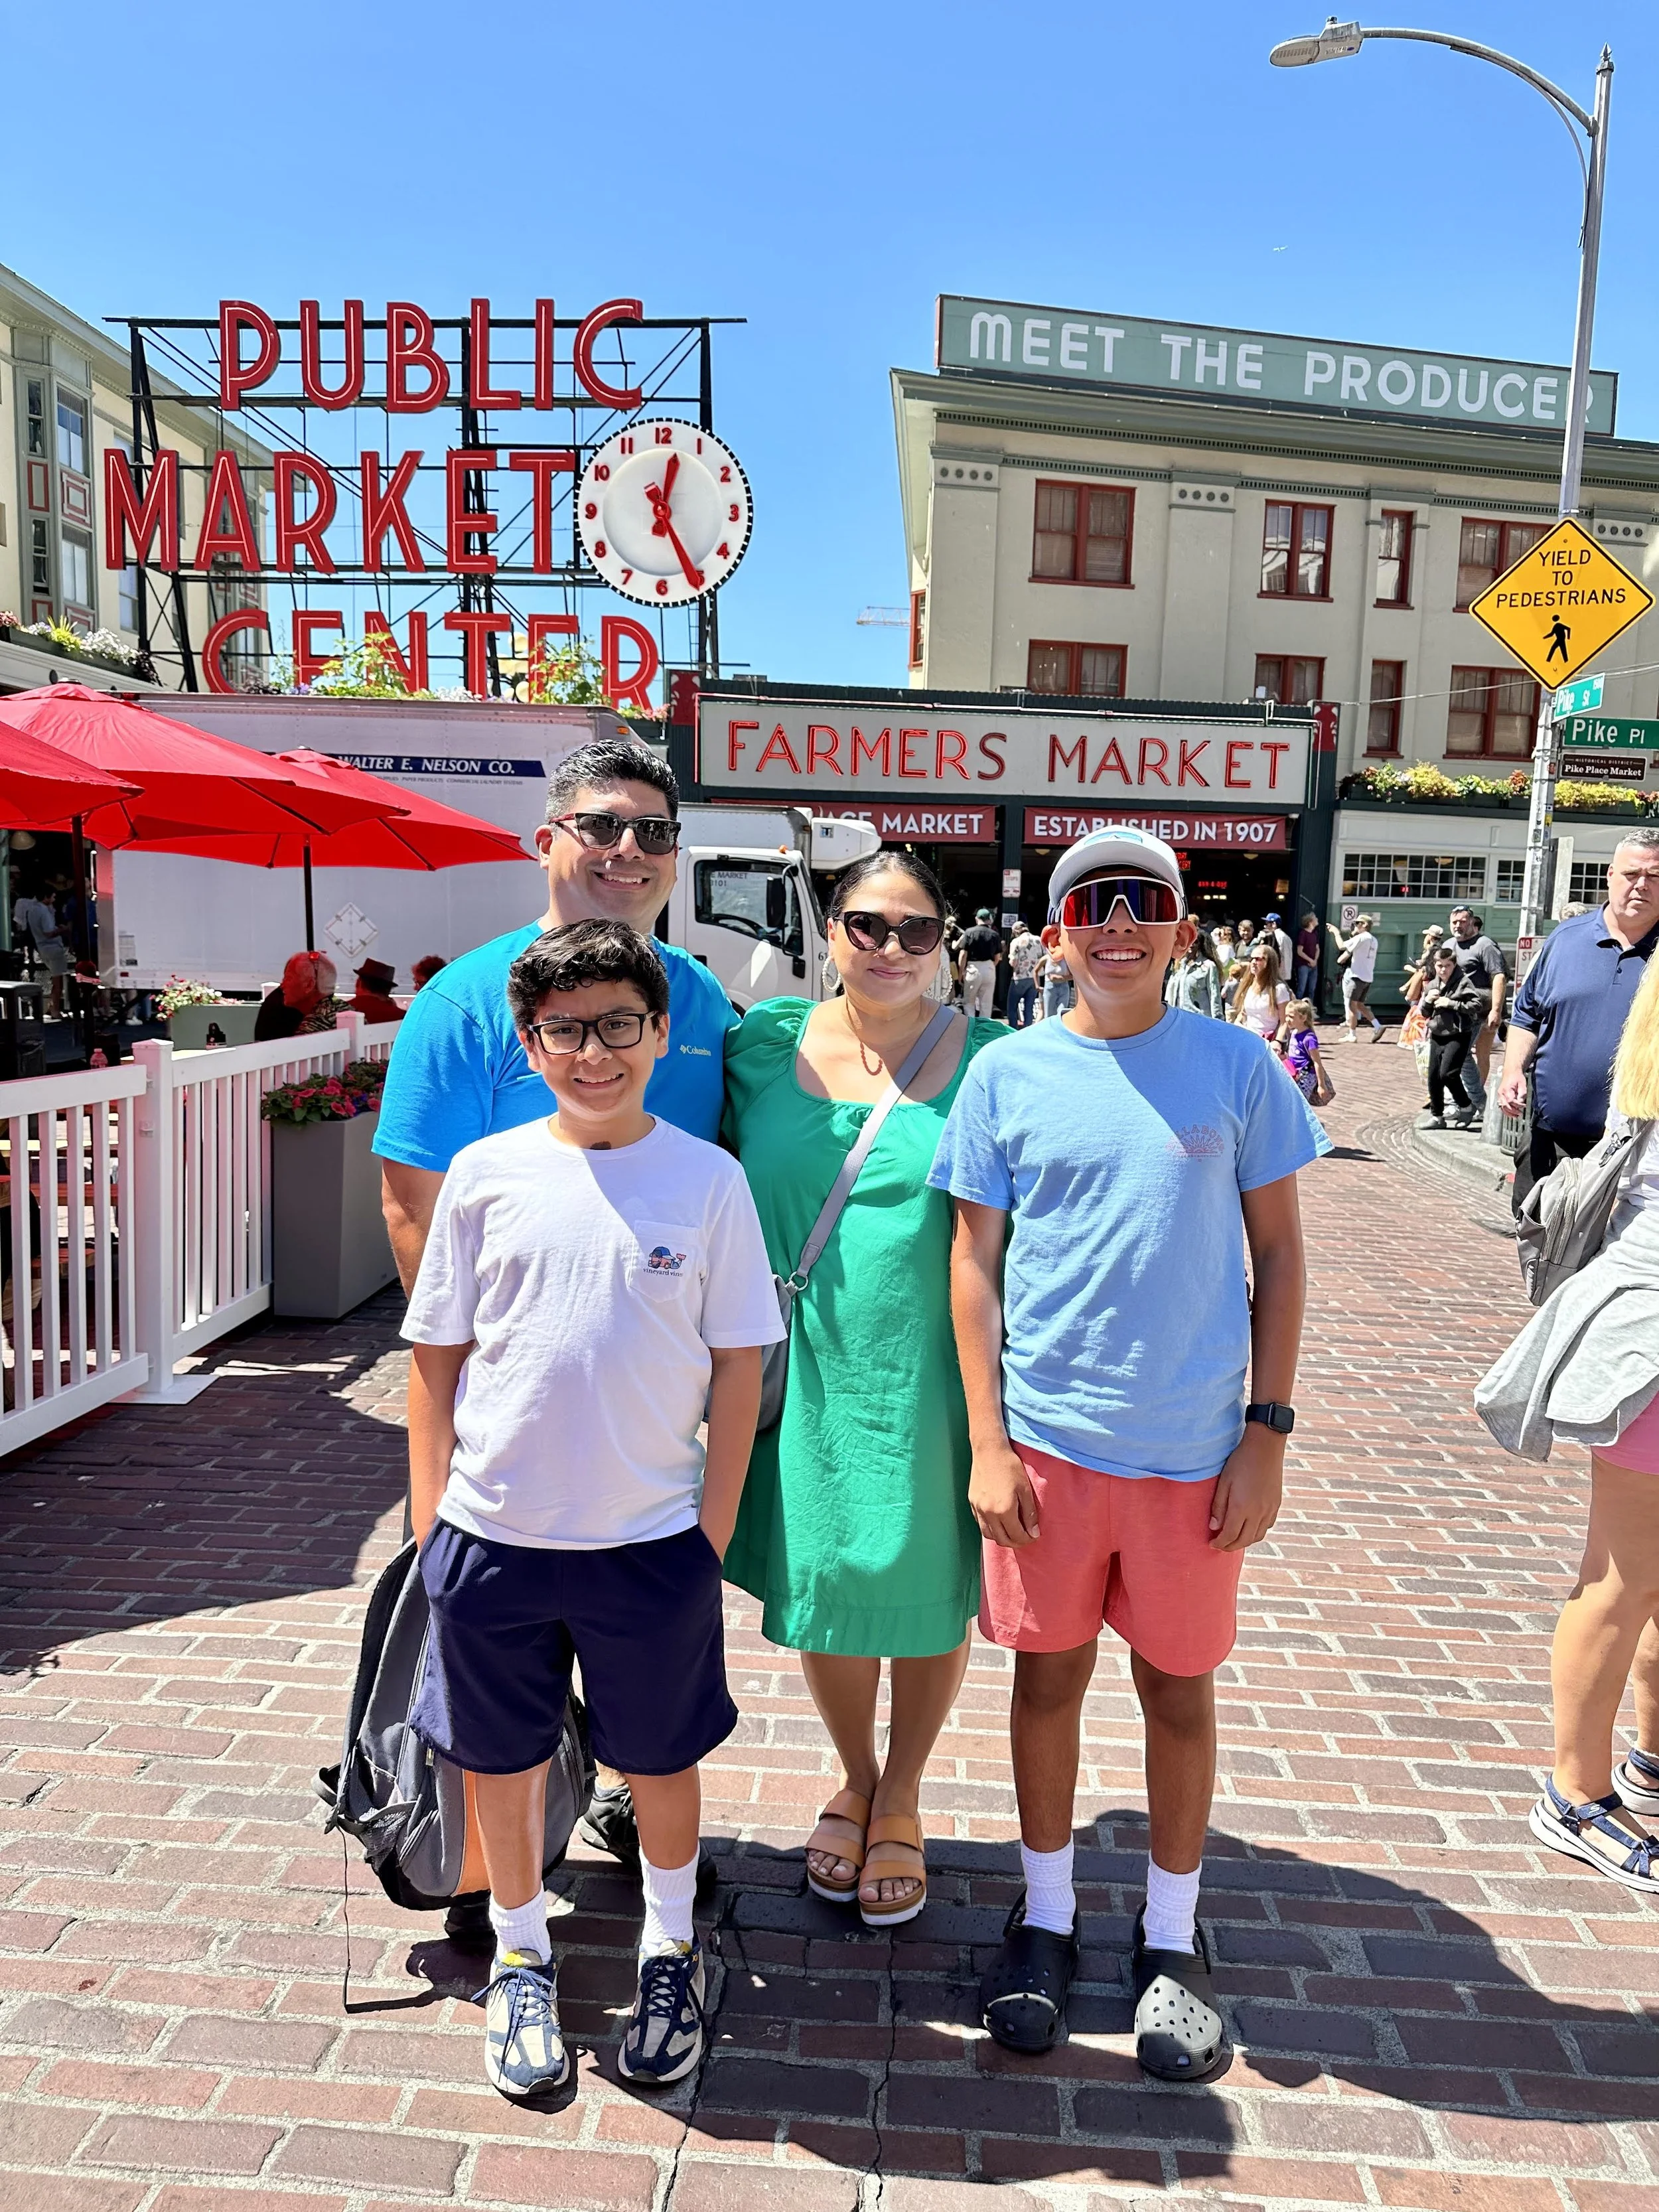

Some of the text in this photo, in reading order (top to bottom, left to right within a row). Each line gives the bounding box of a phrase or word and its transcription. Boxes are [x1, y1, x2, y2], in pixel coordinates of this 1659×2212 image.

[219, 298, 643, 413] PUBLIC
[970, 311, 1125, 373] MEET
[1161, 333, 1263, 390] THE
[655, 427, 672, 444] 12
[620, 437, 633, 454] 11
[697, 438, 701, 455] 1
[594, 465, 610, 481] 10
[720, 466, 731, 482] 2
[104, 449, 575, 575] MARKET
[585, 502, 597, 520] 9
[728, 504, 739, 522] 3
[594, 541, 607, 557] 8
[716, 542, 730, 559] 4
[1538, 549, 1591, 567] YIELD
[621, 569, 633, 585] 7
[1551, 570, 1573, 586] TO
[656, 579, 668, 596] 6
[1496, 587, 1626, 609] PEDESTRIANS
[202, 609, 659, 711] CENTER
[1557, 688, 1591, 713] Pike St
[1572, 719, 1645, 745] Pike Pl
[728, 720, 1290, 789] FARMERS MARKET
[338, 755, 515, 774] WALTER E. NELSON CO.
[1565, 765, 1642, 776] Pike Place Market
[882, 812, 983, 834] MARKET
[1194, 822, 1216, 841] IN
[1224, 822, 1277, 843] 1907
[1520, 939, 1530, 948] NO
[686, 1045, 711, 1056] Columbia
